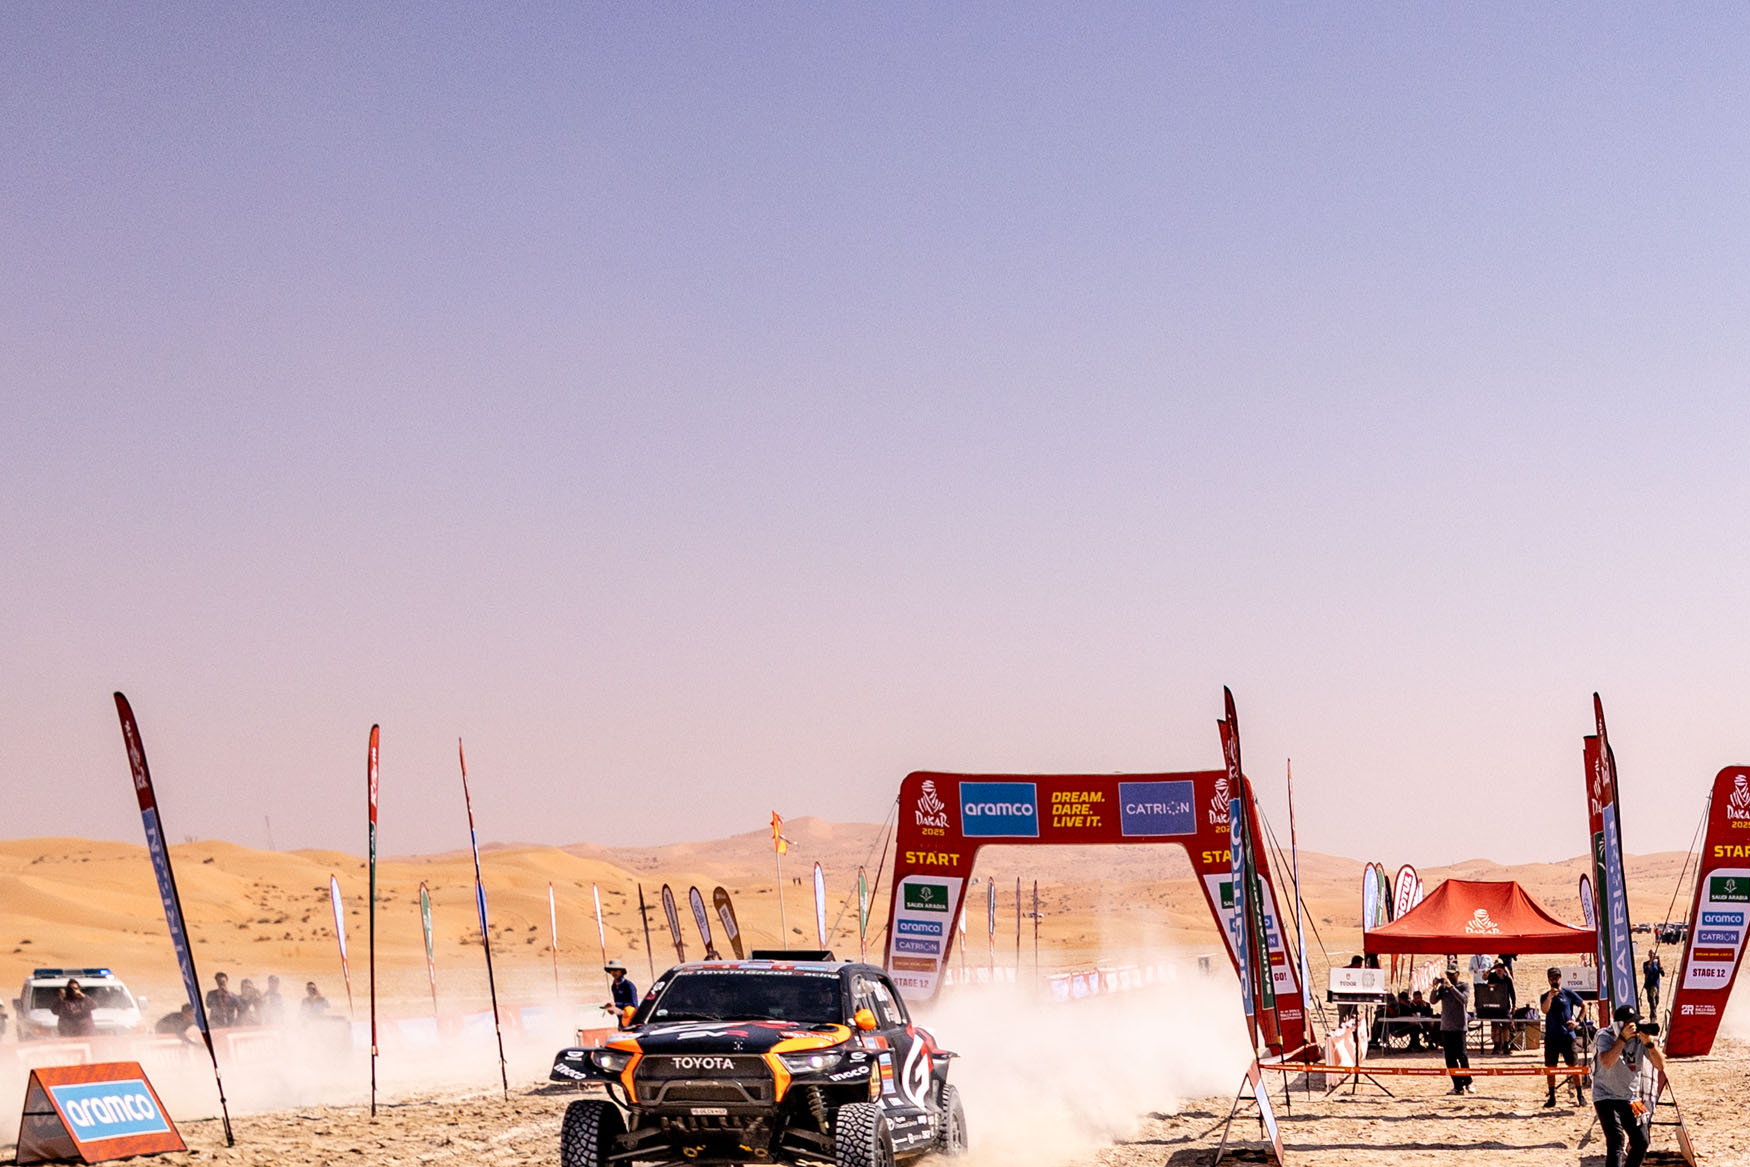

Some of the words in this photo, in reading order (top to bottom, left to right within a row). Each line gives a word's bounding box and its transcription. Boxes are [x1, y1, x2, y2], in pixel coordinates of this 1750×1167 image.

[1051, 791, 1106, 803] DREAM.
[964, 802, 1034, 816] aramco
[1052, 803, 1094, 815] DARE.
[1126, 801, 1190, 815] CATRION
[914, 810, 950, 828] DAKAR
[1053, 815, 1084, 827] LIVE
[1086, 815, 1103, 827] IT.
[1208, 809, 1231, 824] DAKA
[921, 828, 946, 836] 2025
[1215, 825, 1231, 834] 202
[905, 850, 960, 866] START
[1202, 849, 1232, 864] STA
[1609, 819, 1631, 1004] CATRION
[1704, 914, 1742, 924] aramco
[900, 923, 940, 933] aramco
[1700, 933, 1737, 942] CATRION
[1273, 971, 1288, 982] GO!
[1692, 967, 1716, 978] STAGE
[1717, 968, 1726, 978] 12
[671, 1057, 735, 1070] TOYOTA
[66, 1094, 156, 1127] aramco
